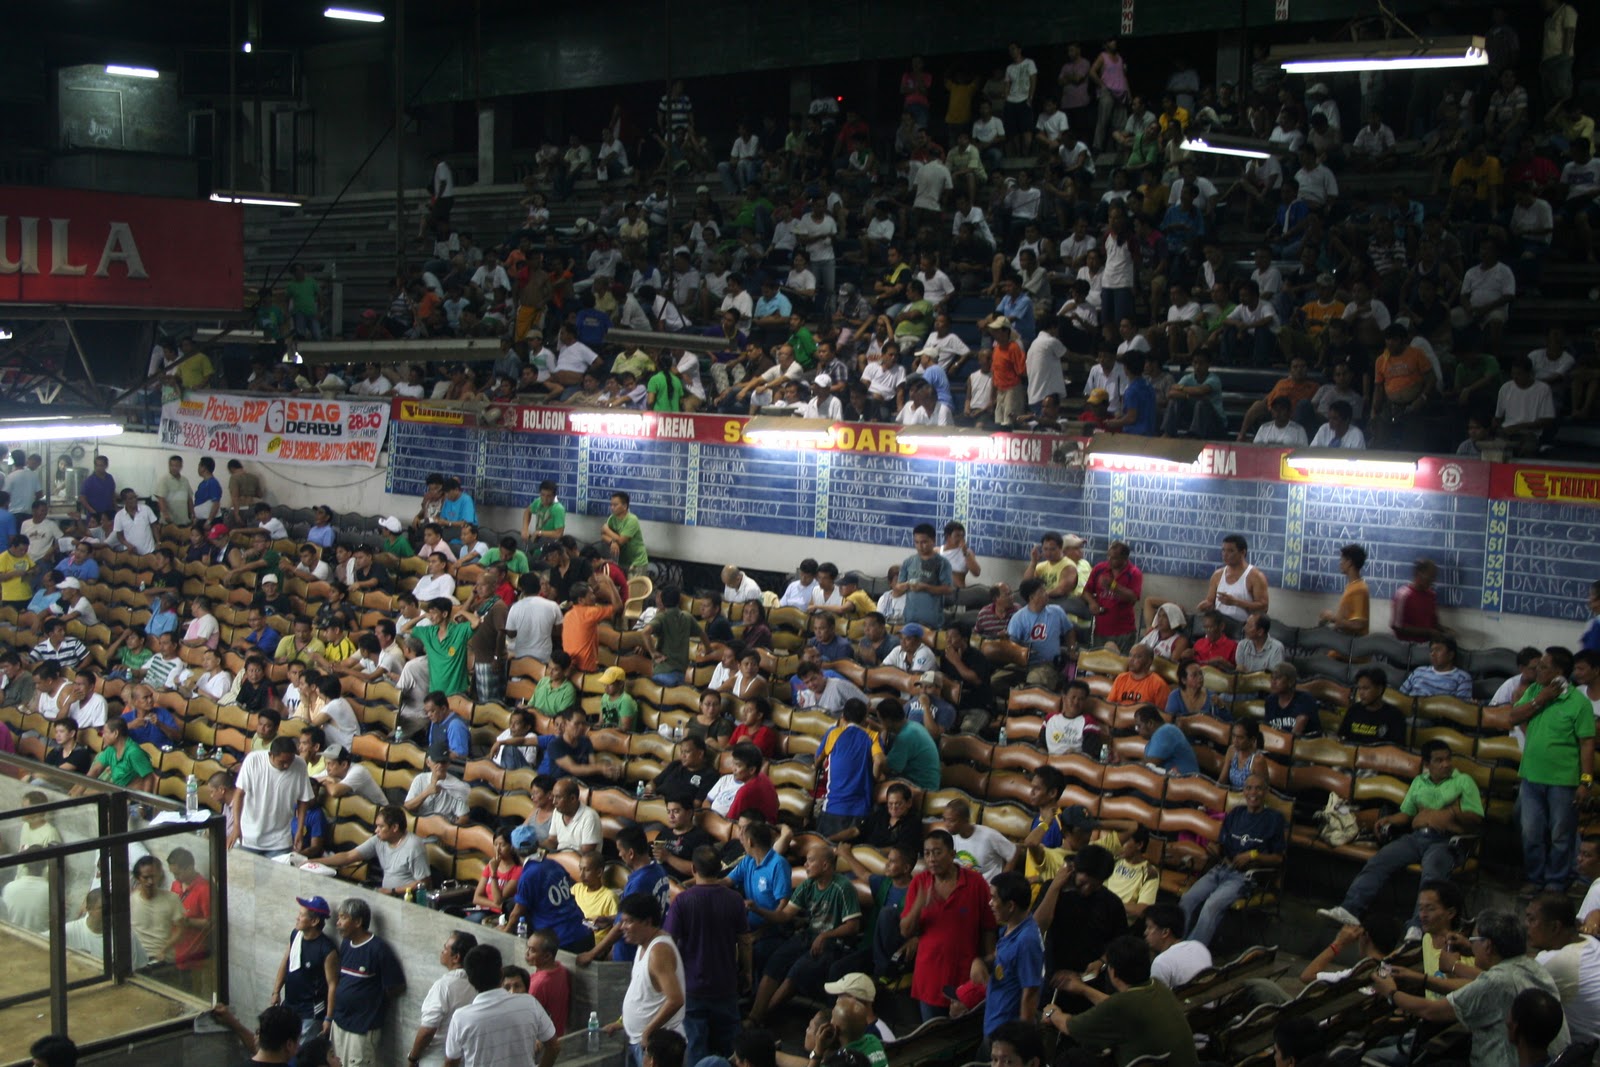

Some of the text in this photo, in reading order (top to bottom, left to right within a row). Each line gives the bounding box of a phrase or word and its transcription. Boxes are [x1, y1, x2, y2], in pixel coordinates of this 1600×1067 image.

[287, 402, 341, 422] STAG
[286, 421, 342, 436] DERBY
[523, 409, 566, 431] ROLIGON
[656, 416, 695, 439] ARENA
[591, 437, 637, 450] CHRISTINA
[832, 453, 914, 473] FIRE AT WILL
[1114, 474, 1126, 486] 37
[1129, 473, 1184, 492] COYOTE
[833, 481, 865, 495] LLOYD
[1113, 490, 1125, 501] 38
[1290, 485, 1304, 500] 43
[1309, 486, 1406, 509] SPARTACUS
[1112, 506, 1124, 518] 39
[1289, 502, 1302, 517] 44
[1491, 501, 1506, 516] 49
[1111, 521, 1124, 535] 40
[1289, 521, 1301, 534] 45
[1489, 520, 1505, 534] 50
[1288, 537, 1300, 552] 46
[1489, 537, 1503, 551] 51
[1287, 555, 1299, 570] 47
[1487, 554, 1503, 568] 52
[1285, 572, 1298, 586] 48
[1486, 571, 1503, 587] 53
[1483, 590, 1499, 605] 54
